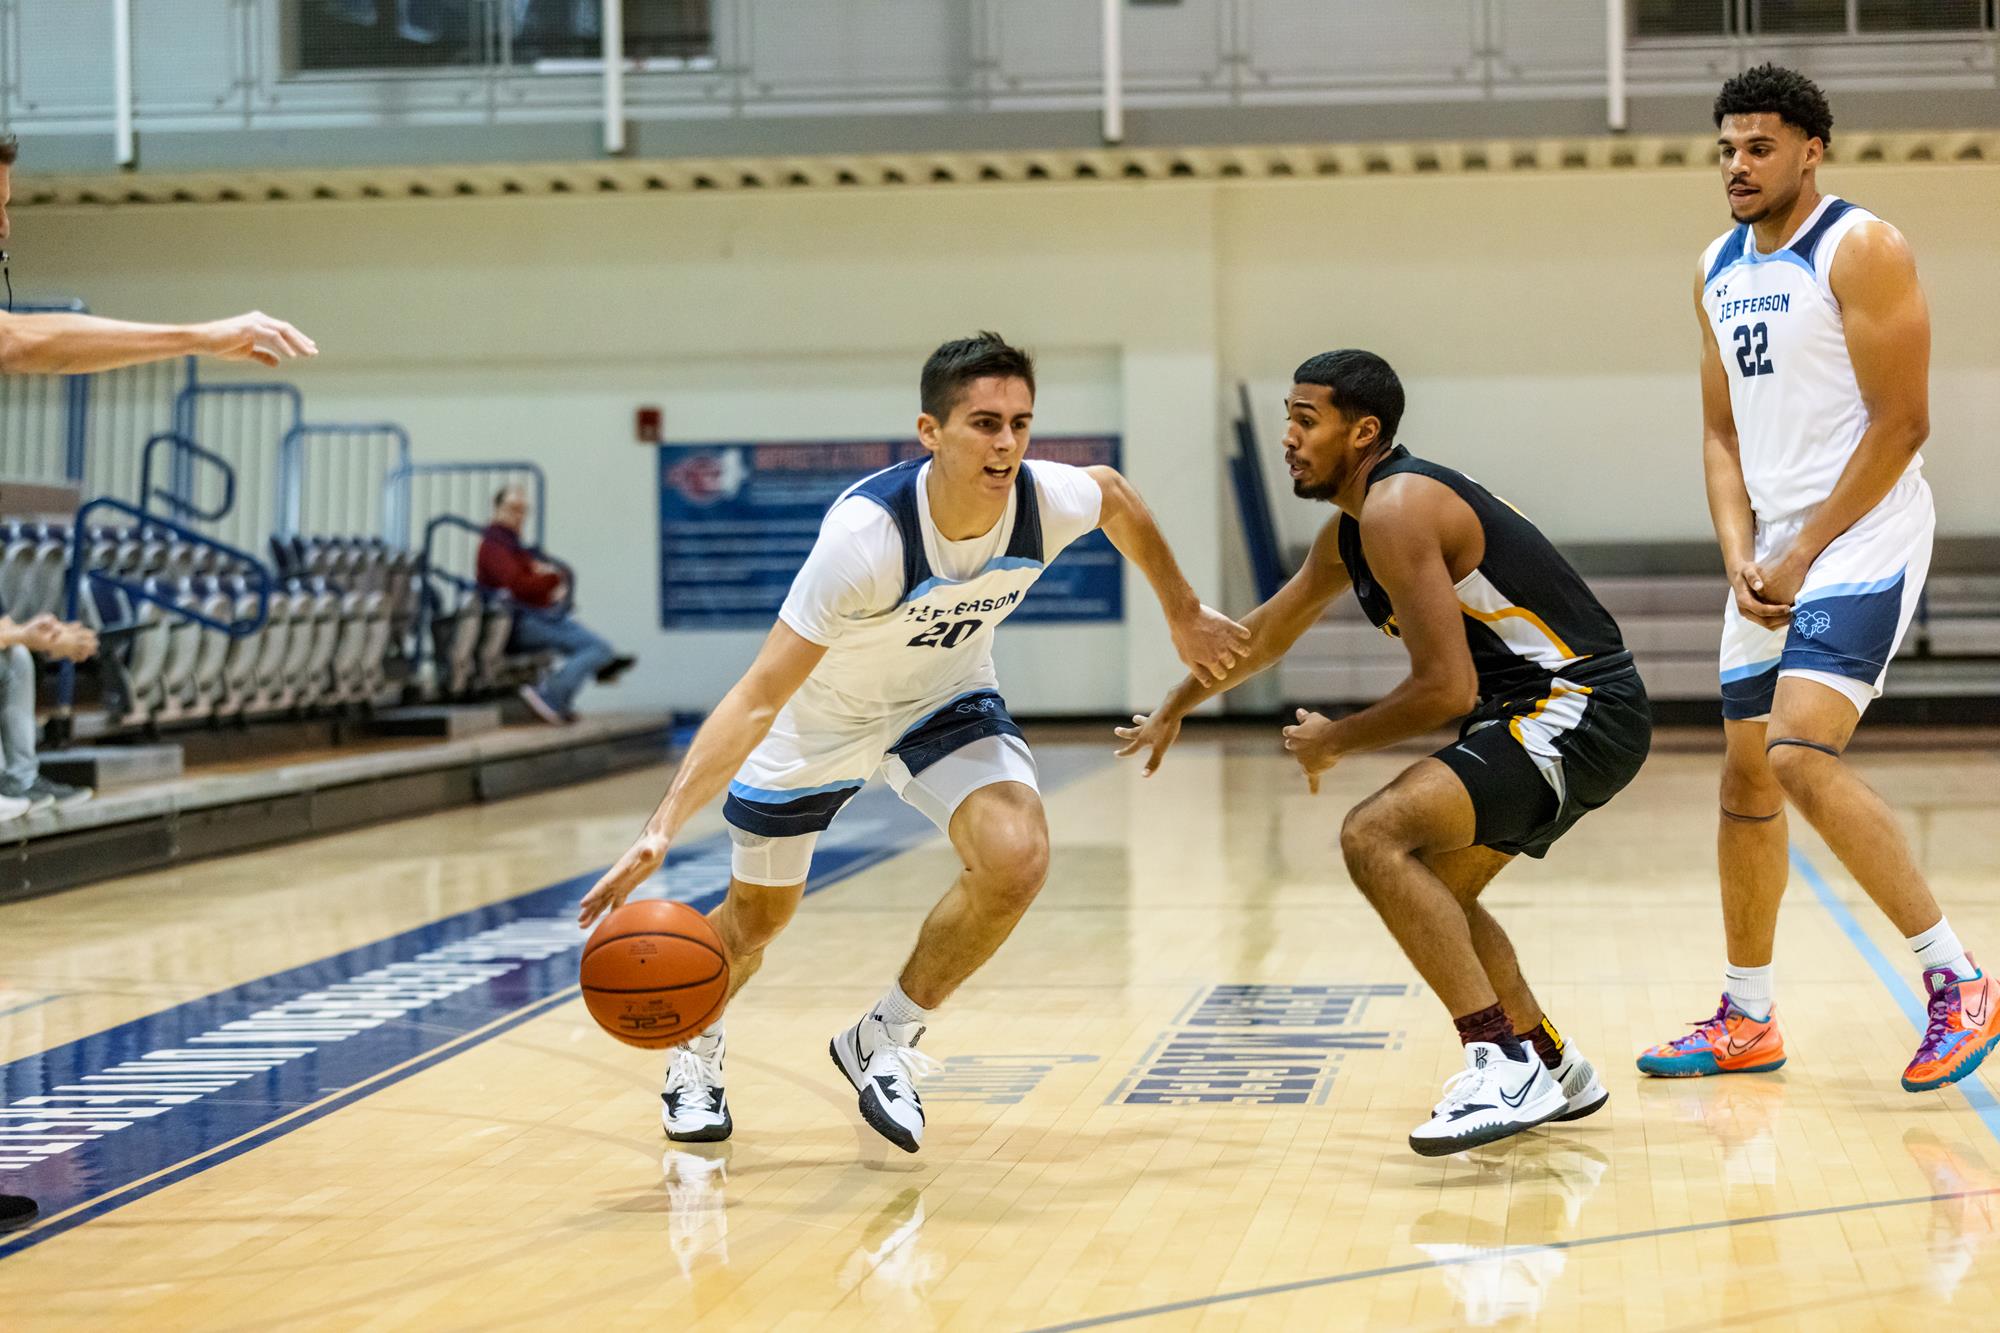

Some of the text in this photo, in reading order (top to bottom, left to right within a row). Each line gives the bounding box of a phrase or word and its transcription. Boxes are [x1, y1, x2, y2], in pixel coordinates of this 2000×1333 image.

[1719, 293, 1790, 323] JEFFERSON
[1733, 321, 1774, 377] 22
[903, 590, 1020, 623] EFERSON
[906, 619, 983, 649] 20
[1123, 1031, 1390, 1104] MAGEE
[0, 1046, 318, 1170] UNIVERSIT
